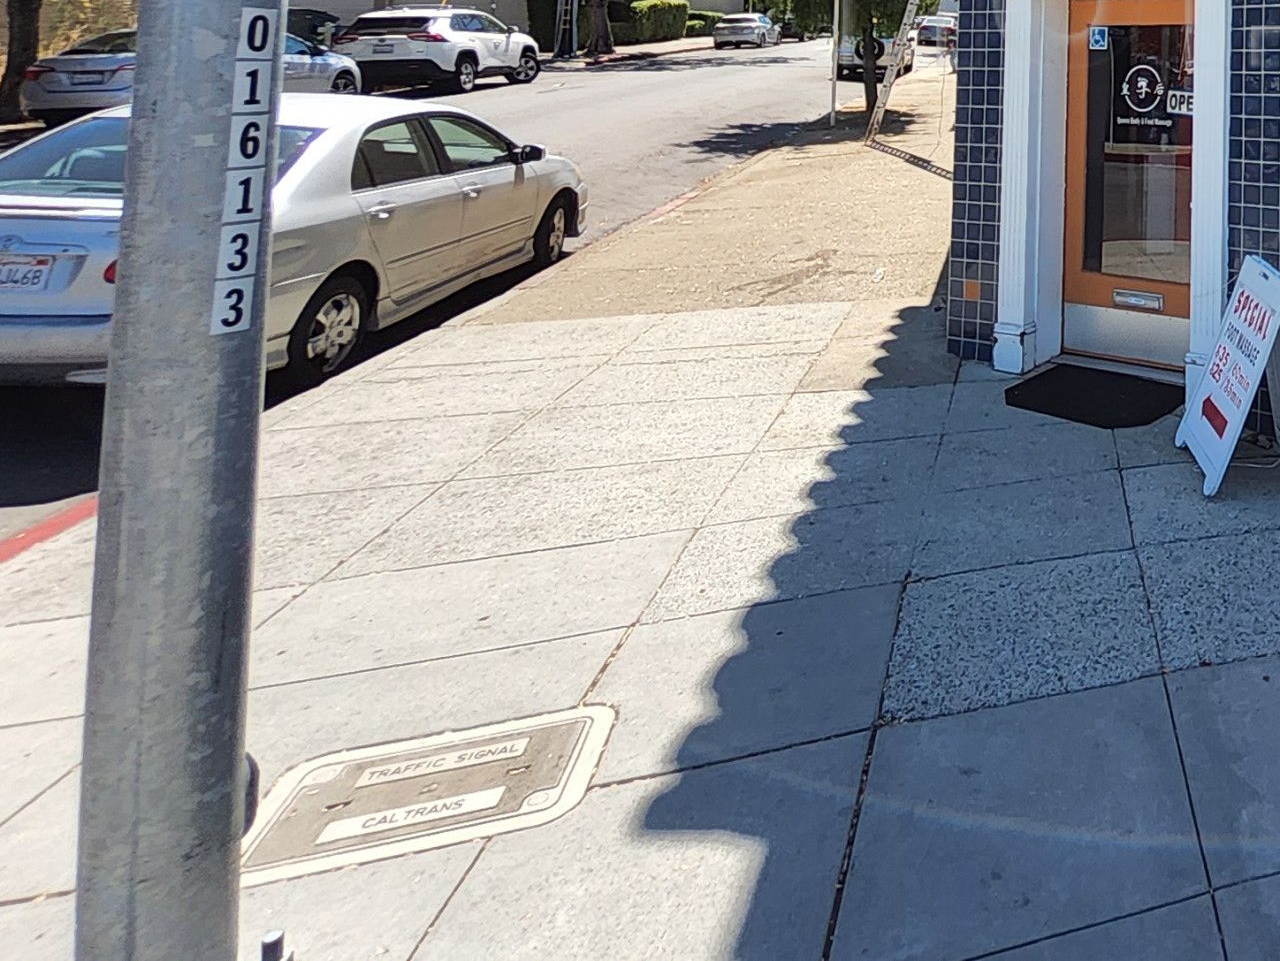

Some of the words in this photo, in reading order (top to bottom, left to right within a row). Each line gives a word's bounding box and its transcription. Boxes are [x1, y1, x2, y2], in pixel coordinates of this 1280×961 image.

[220, 14, 270, 328] 016133
[1233, 289, 1272, 341] SPECIAL
[1223, 321, 1240, 346] FOOT
[1235, 333, 1260, 367] MASSAGE
[367, 757, 447, 781] TRAFFIC
[456, 743, 519, 764] SIGNAL
